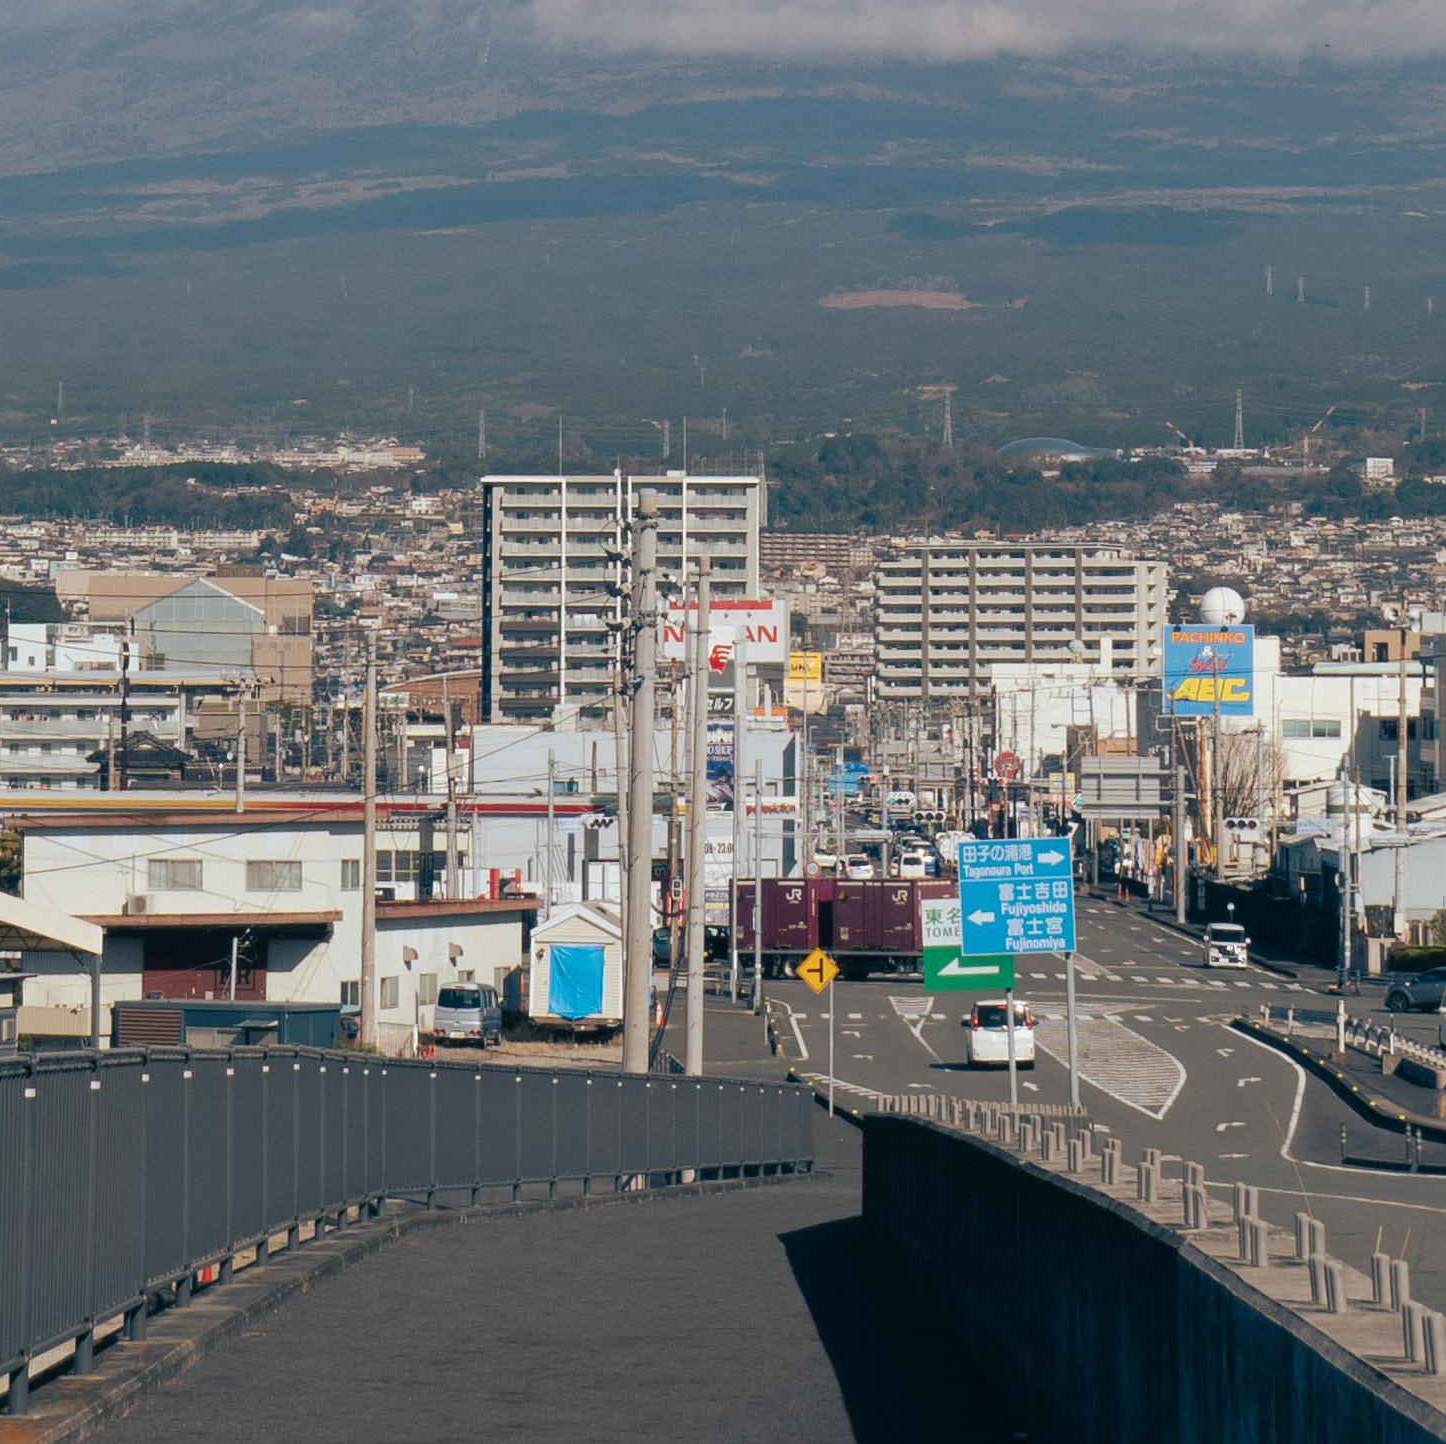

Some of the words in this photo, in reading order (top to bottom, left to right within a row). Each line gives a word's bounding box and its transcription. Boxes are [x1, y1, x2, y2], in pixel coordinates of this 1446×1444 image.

[1171, 631, 1246, 644] PACHINKO
[1202, 645, 1214, 657] &
[1166, 677, 1250, 702] ABC
[963, 844, 1033, 863] 田子の浦港
[963, 864, 1011, 879] Tagonoura
[1014, 863, 1034, 876] Port
[786, 888, 802, 901] JR
[891, 889, 908, 902] JR
[998, 881, 1068, 901] 富士吉田
[1001, 901, 1068, 917] Fujiyoshida
[925, 927, 960, 938] TOME
[1006, 917, 1063, 936] 富士宮
[1006, 937, 1066, 952] Fujinomiya
